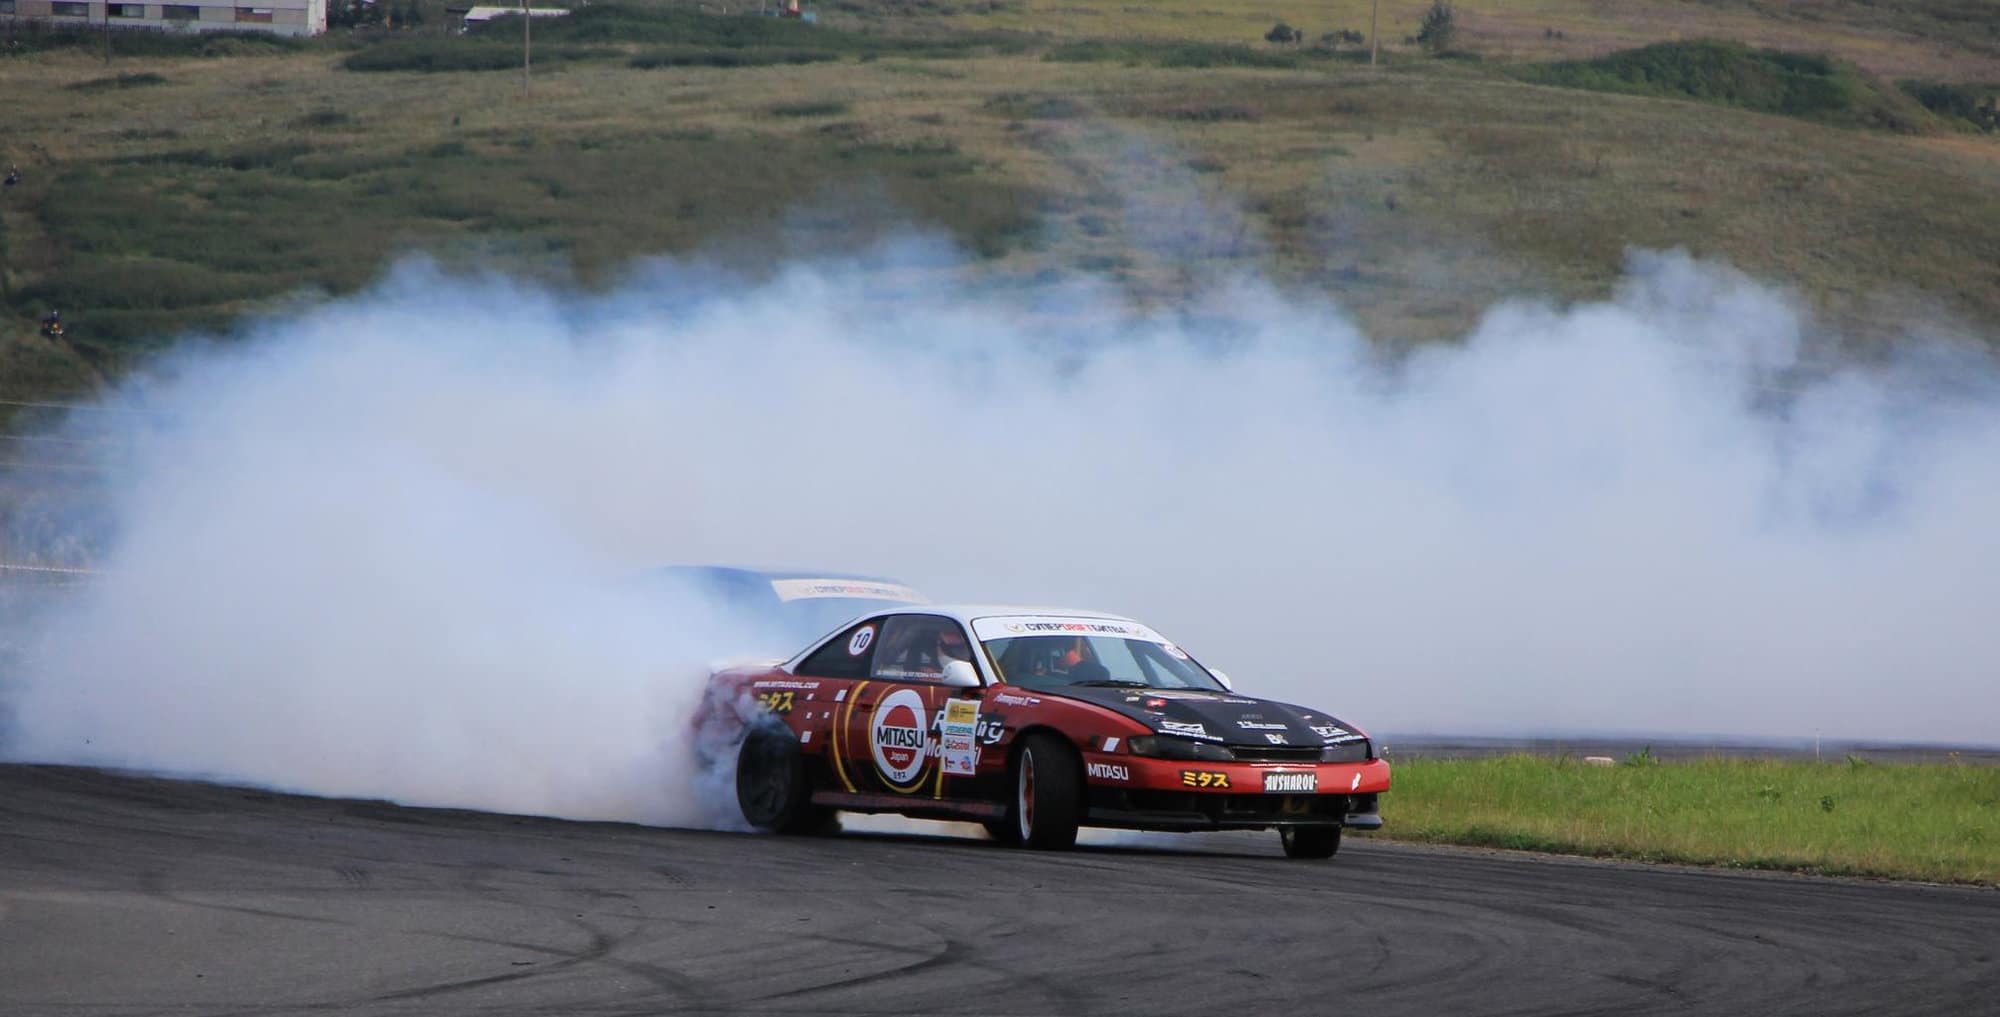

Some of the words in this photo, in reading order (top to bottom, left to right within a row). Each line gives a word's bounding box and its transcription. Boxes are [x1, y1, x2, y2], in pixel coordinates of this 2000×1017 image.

[853, 632, 871, 648] 10
[877, 726, 925, 749] MITASU
[1088, 763, 1129, 781] MITASU
[1183, 771, 1229, 788] ミタス
[1265, 774, 1315, 791] AVSHAROV
